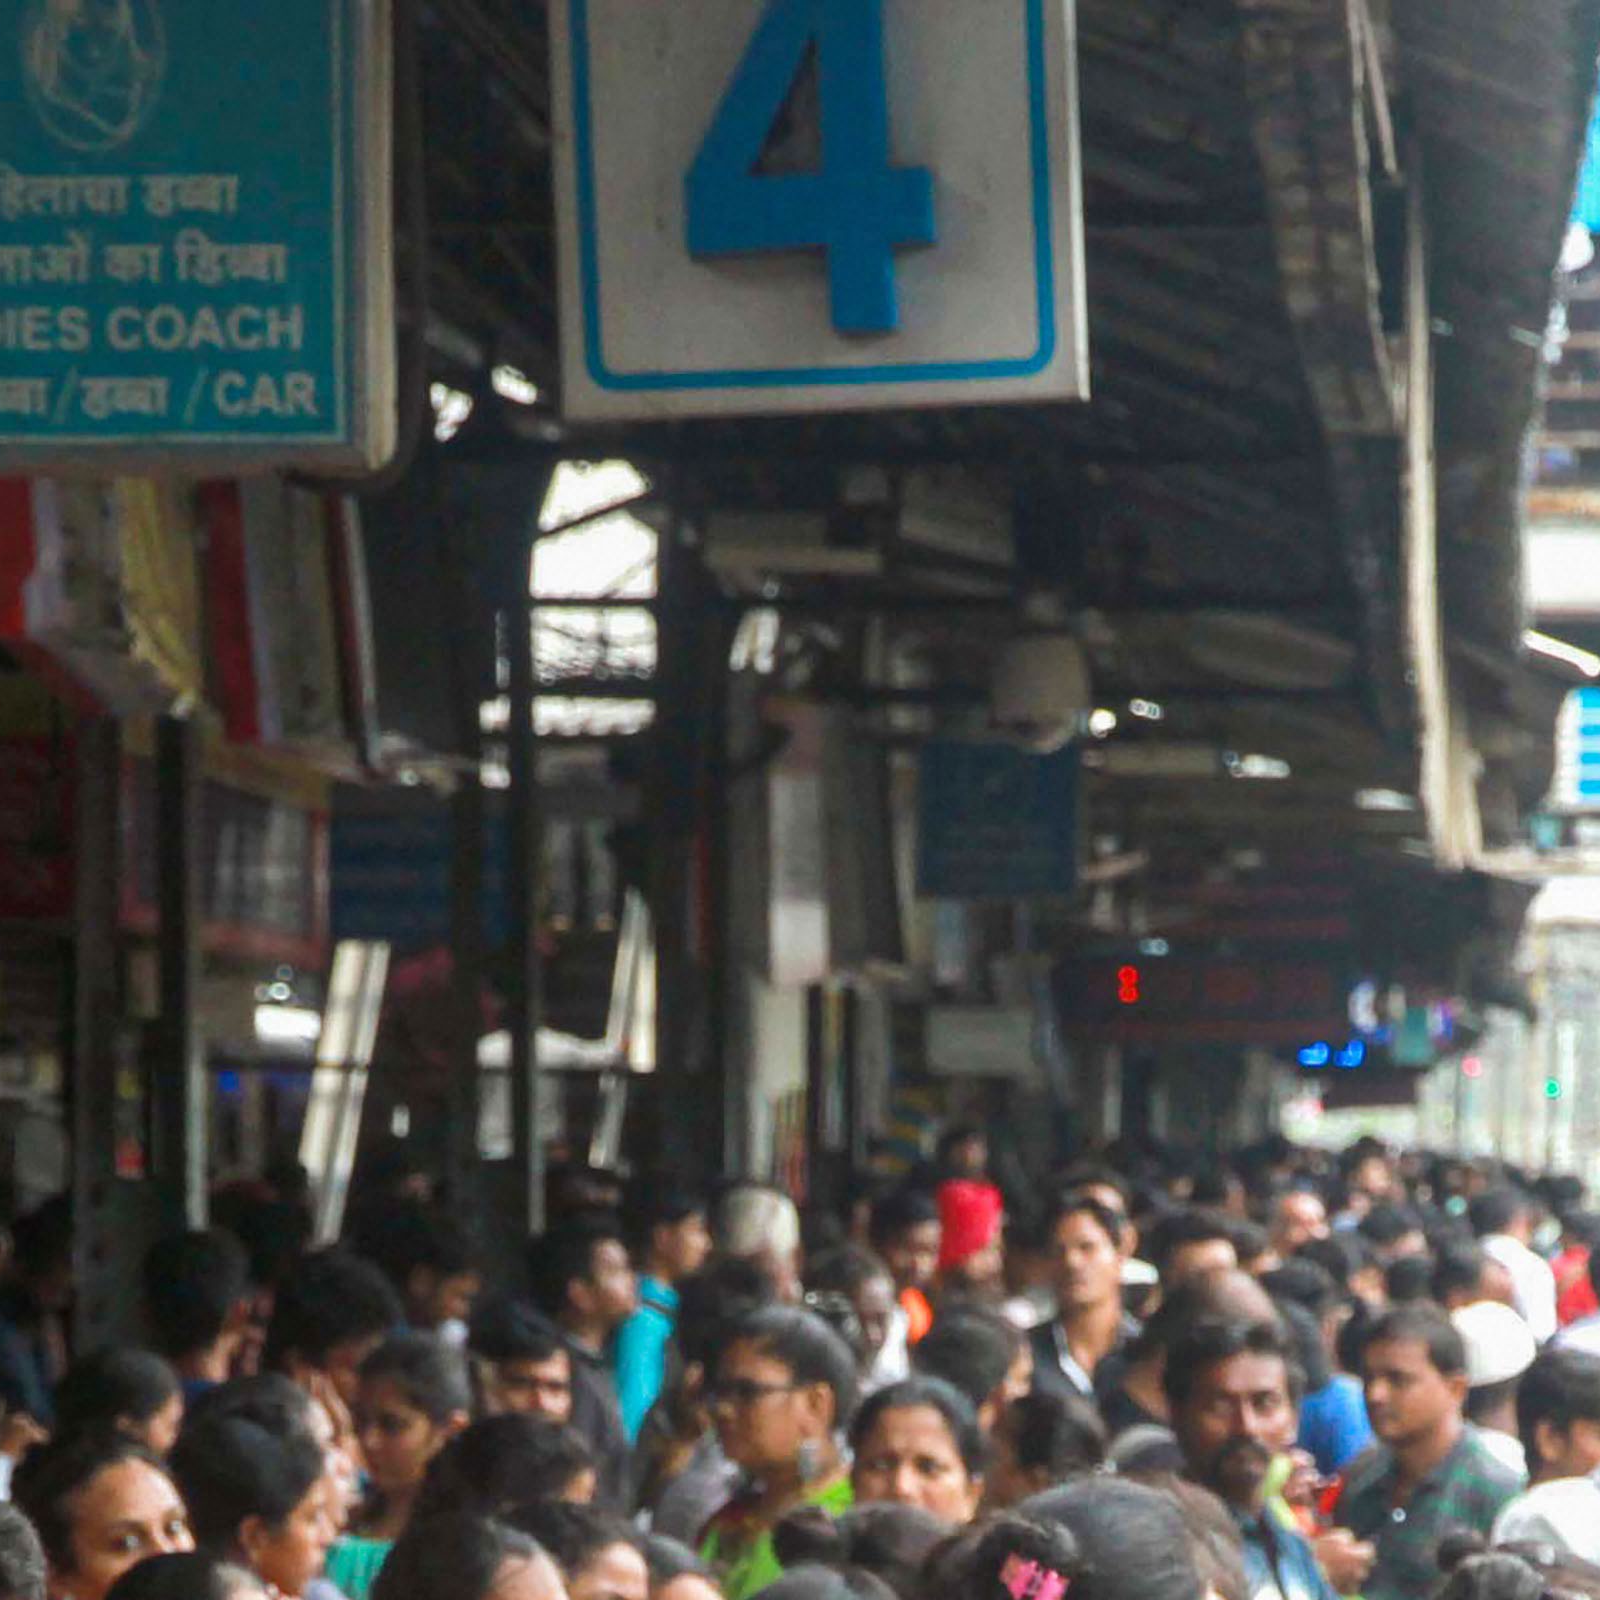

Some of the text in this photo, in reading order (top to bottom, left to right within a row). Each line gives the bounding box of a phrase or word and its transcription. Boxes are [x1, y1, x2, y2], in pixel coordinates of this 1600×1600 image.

[684, 0, 935, 333] 4
[103, 243, 162, 284] का
[106, 304, 304, 352] COACH
